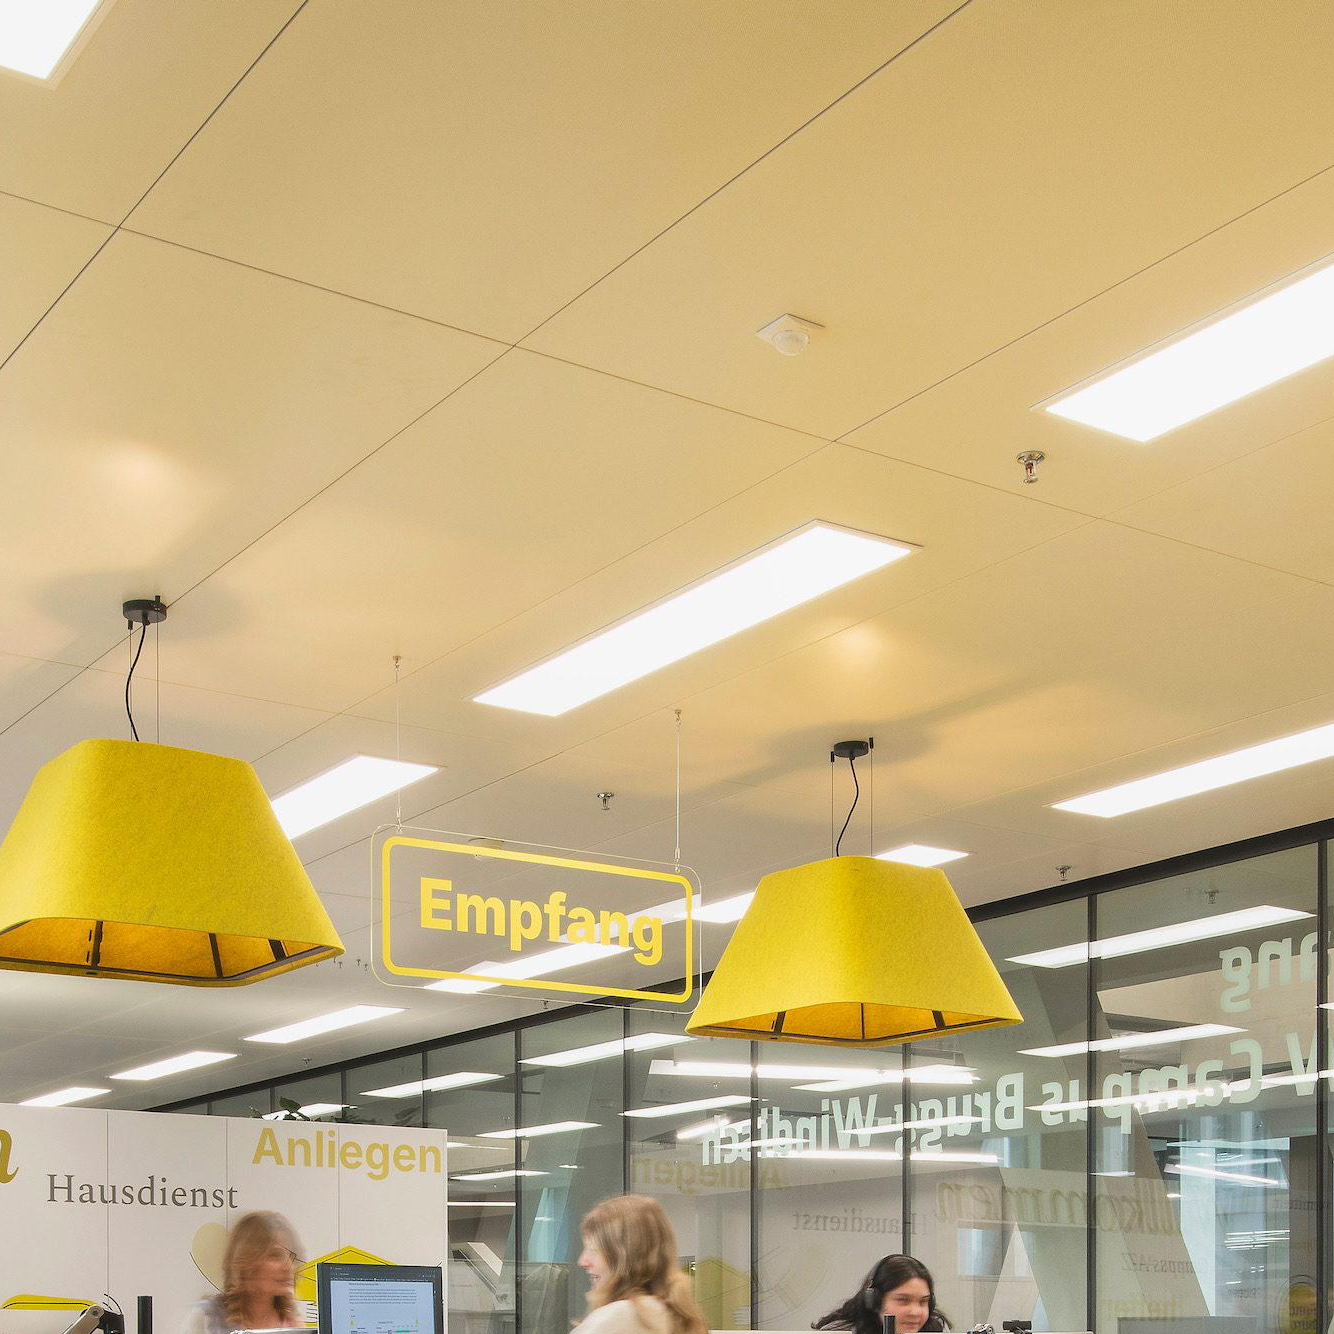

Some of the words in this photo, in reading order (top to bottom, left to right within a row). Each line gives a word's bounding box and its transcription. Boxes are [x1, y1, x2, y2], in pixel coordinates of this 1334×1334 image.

[420, 876, 663, 966] Empfang
[250, 1127, 443, 1181] Anliegen
[46, 1173, 239, 1210] Hausdienst
